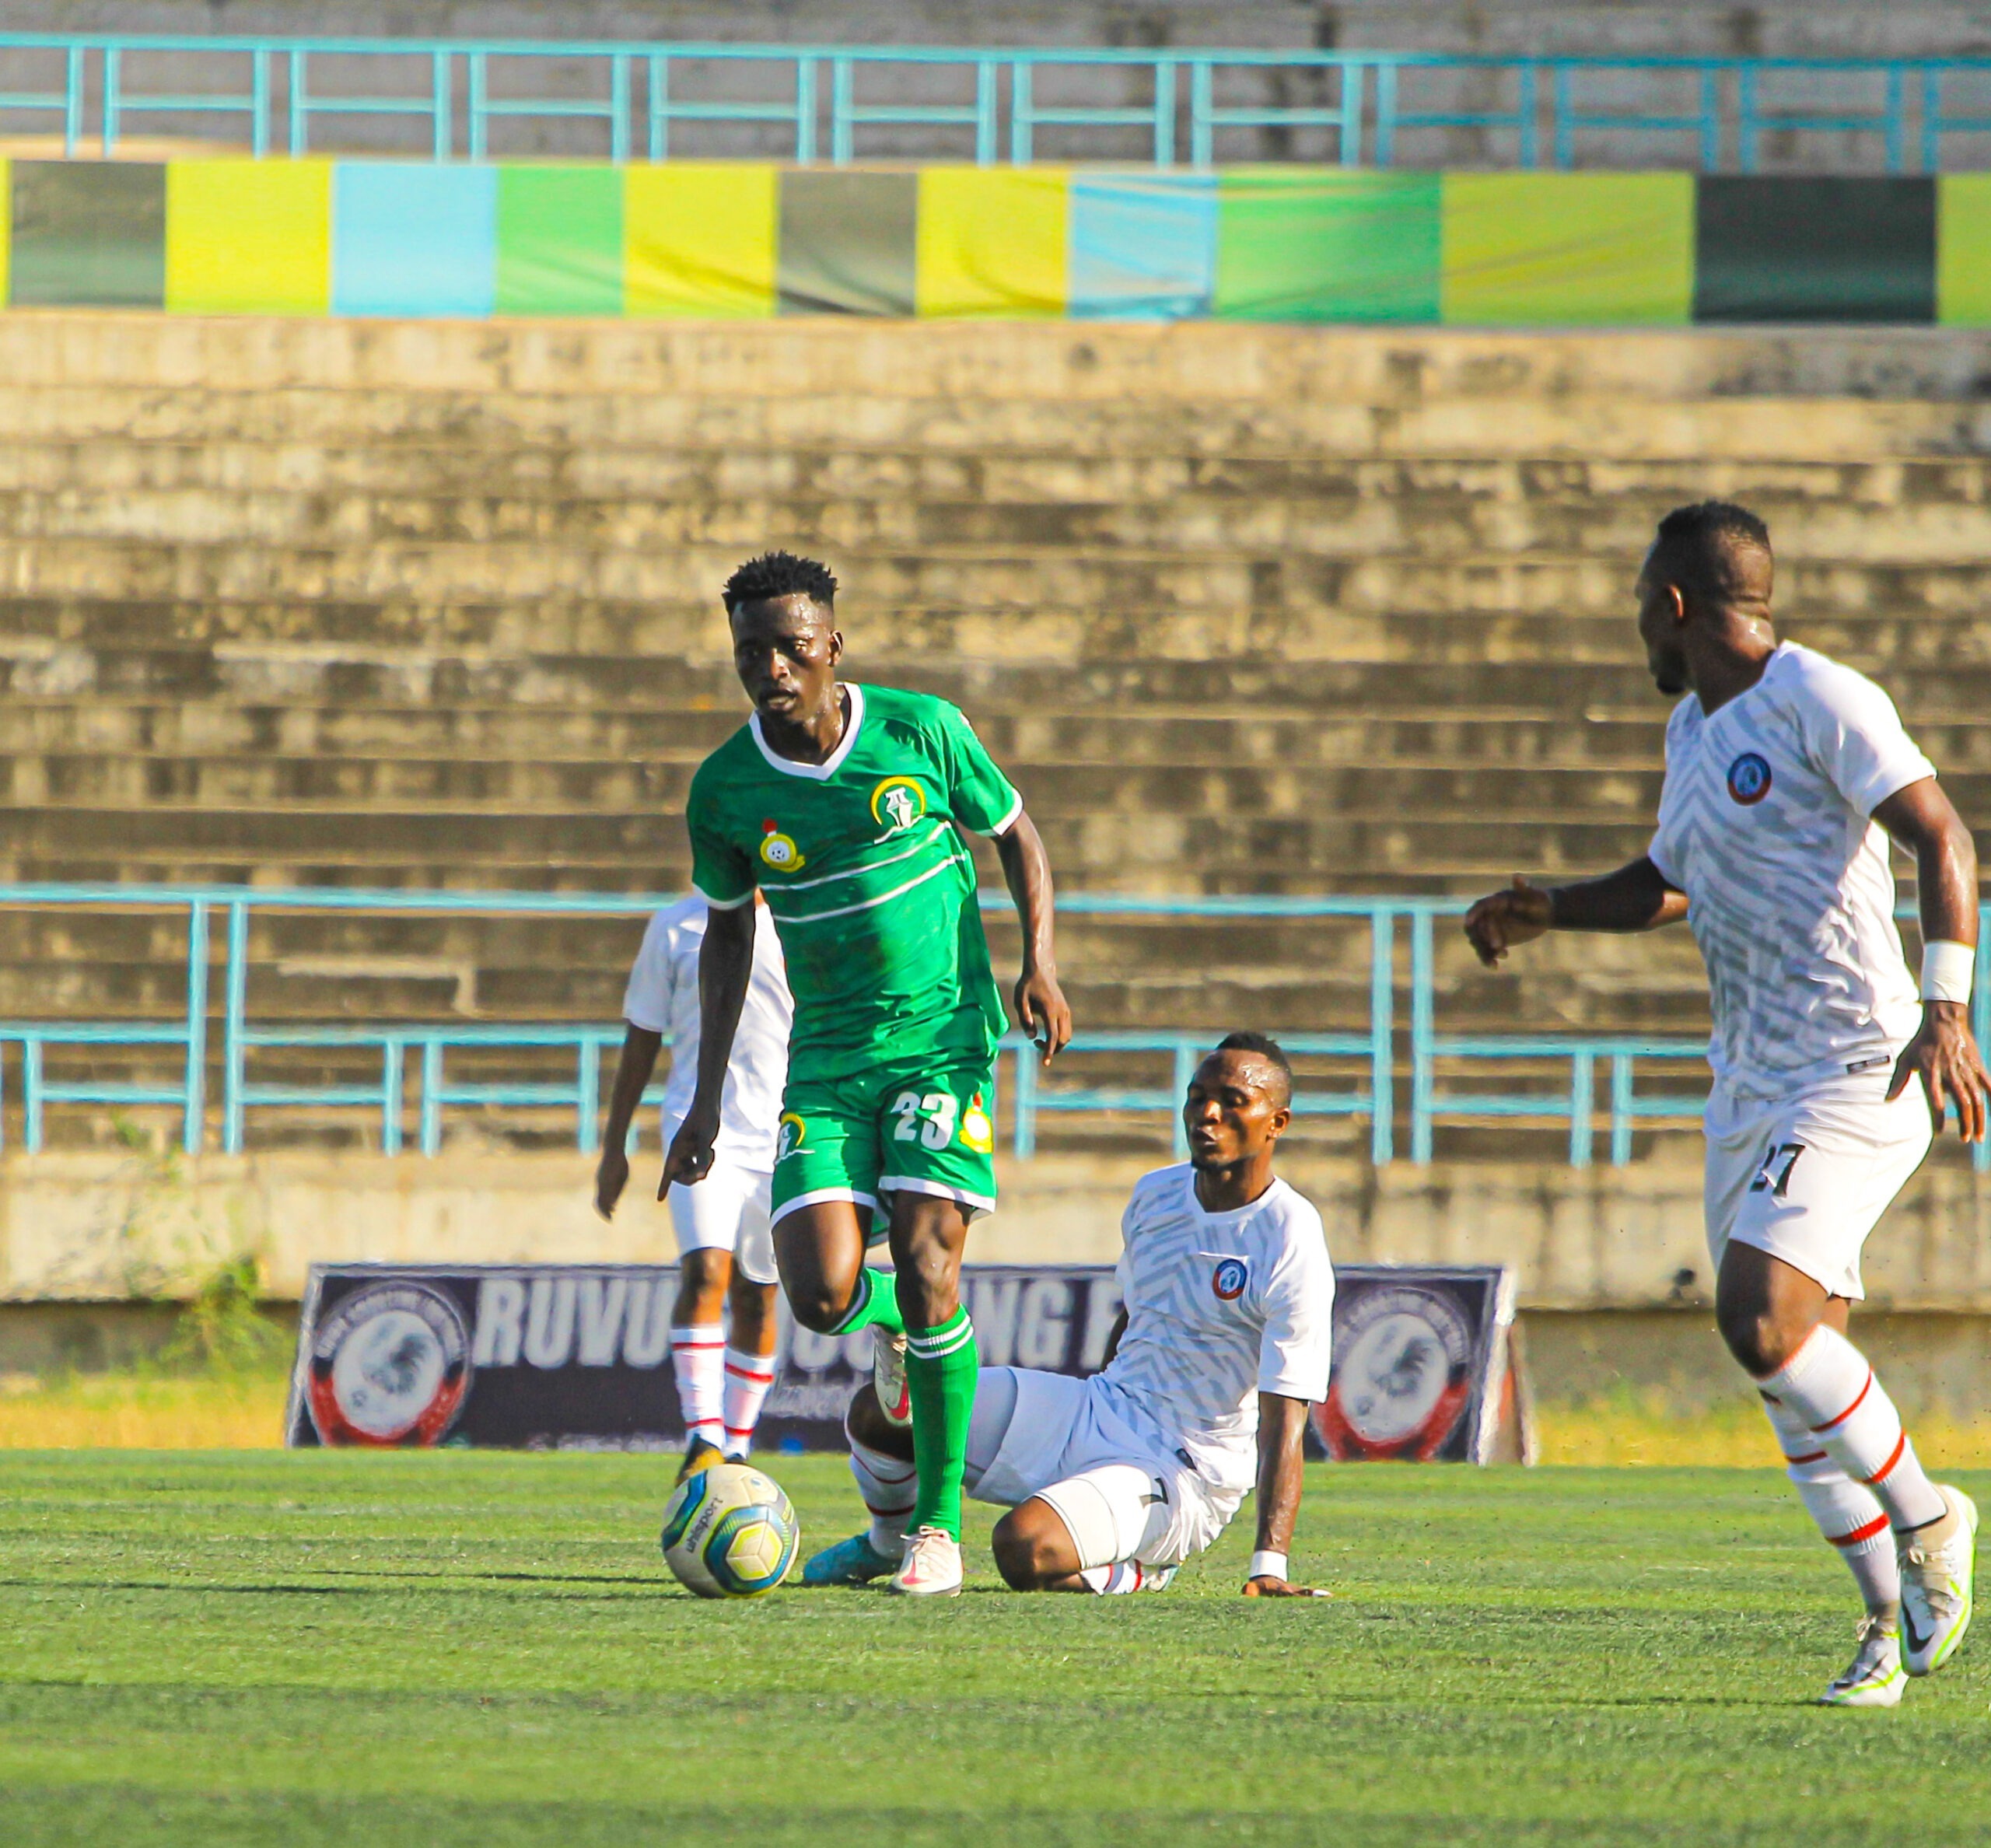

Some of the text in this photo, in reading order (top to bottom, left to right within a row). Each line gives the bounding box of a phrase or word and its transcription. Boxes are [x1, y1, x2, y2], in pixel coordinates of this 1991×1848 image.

[891, 1091, 957, 1150] 23
[472, 1278, 679, 1370] RUVU
[686, 1496, 724, 1553] uhlsport
